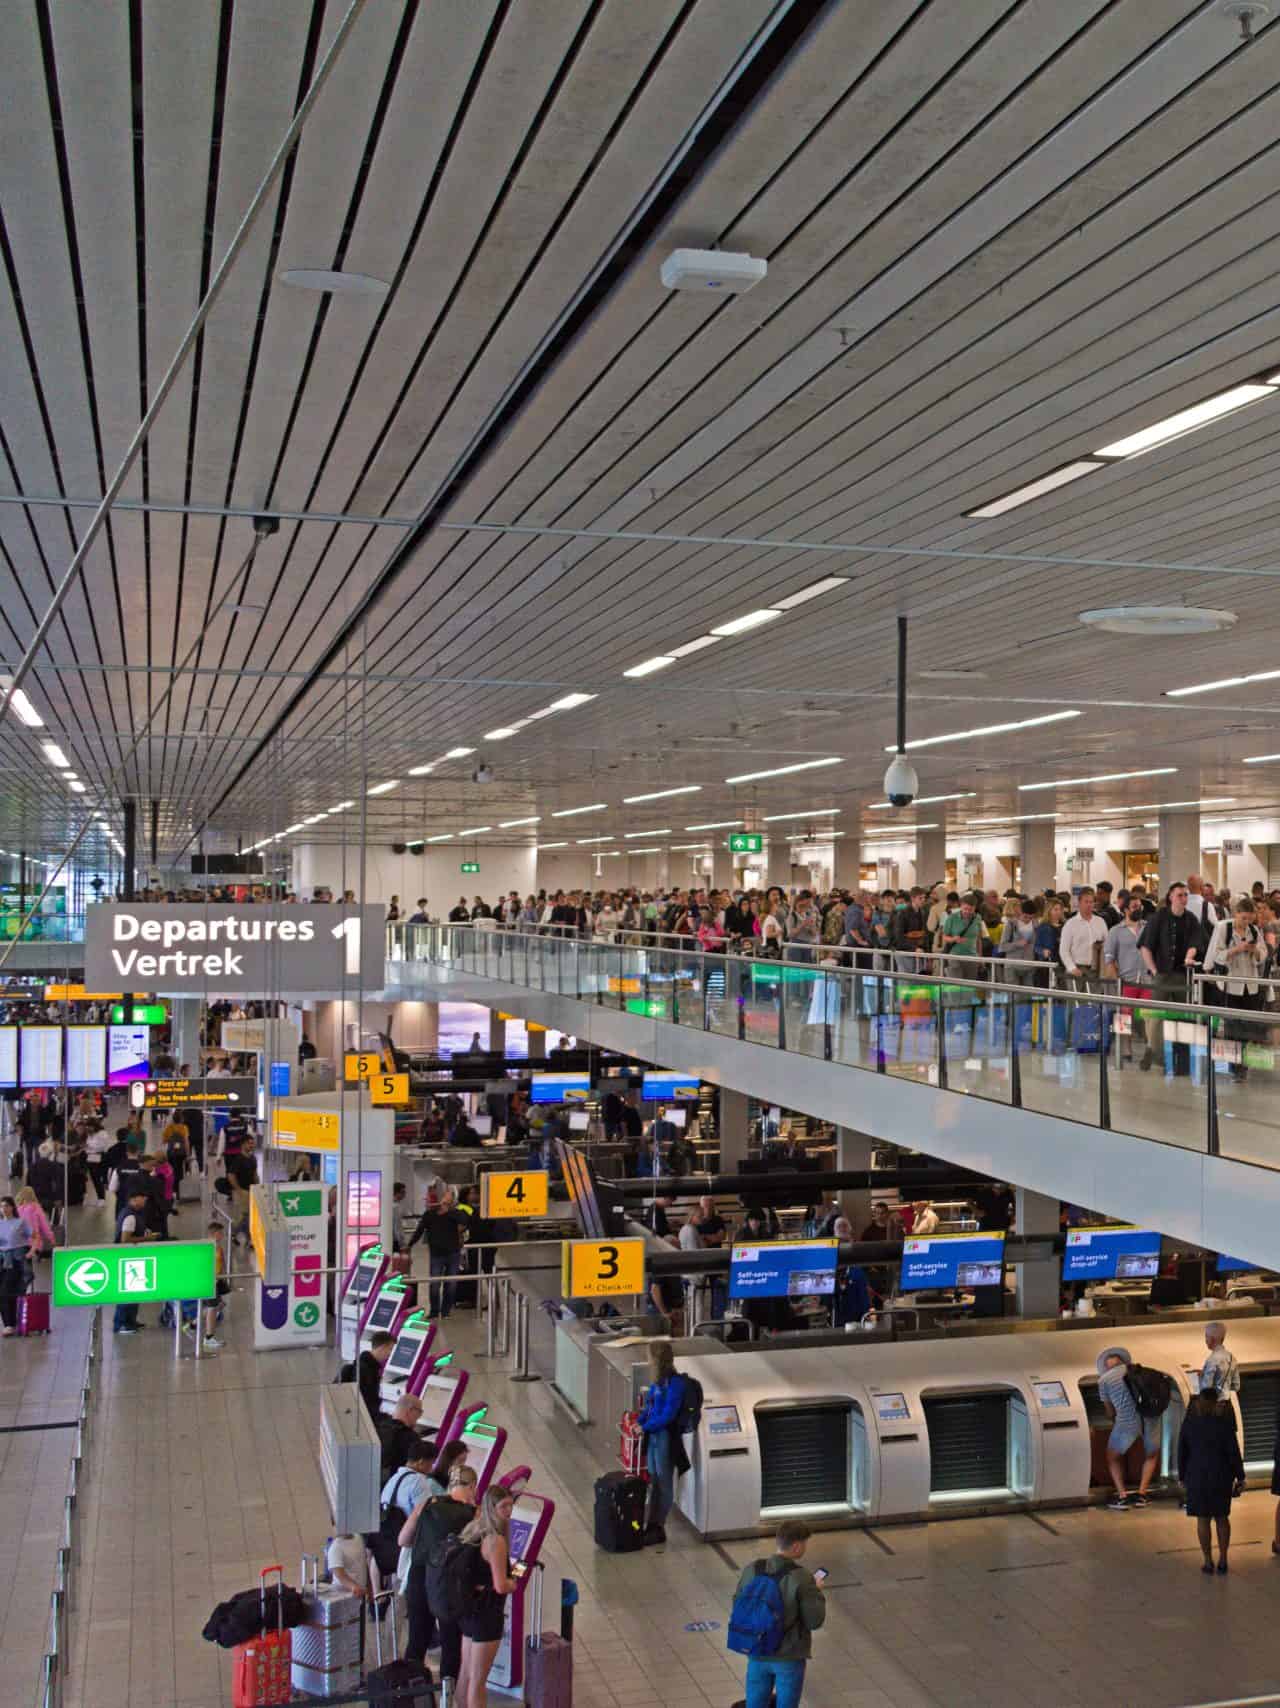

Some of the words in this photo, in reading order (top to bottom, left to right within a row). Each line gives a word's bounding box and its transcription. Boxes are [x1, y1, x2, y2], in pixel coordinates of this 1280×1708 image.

[113, 914, 314, 948] Departures
[331, 917, 361, 975] 1
[112, 947, 244, 977] Vertrek
[383, 1077, 394, 1095] 5
[506, 1177, 526, 1204] 4
[597, 1245, 619, 1280] 3
